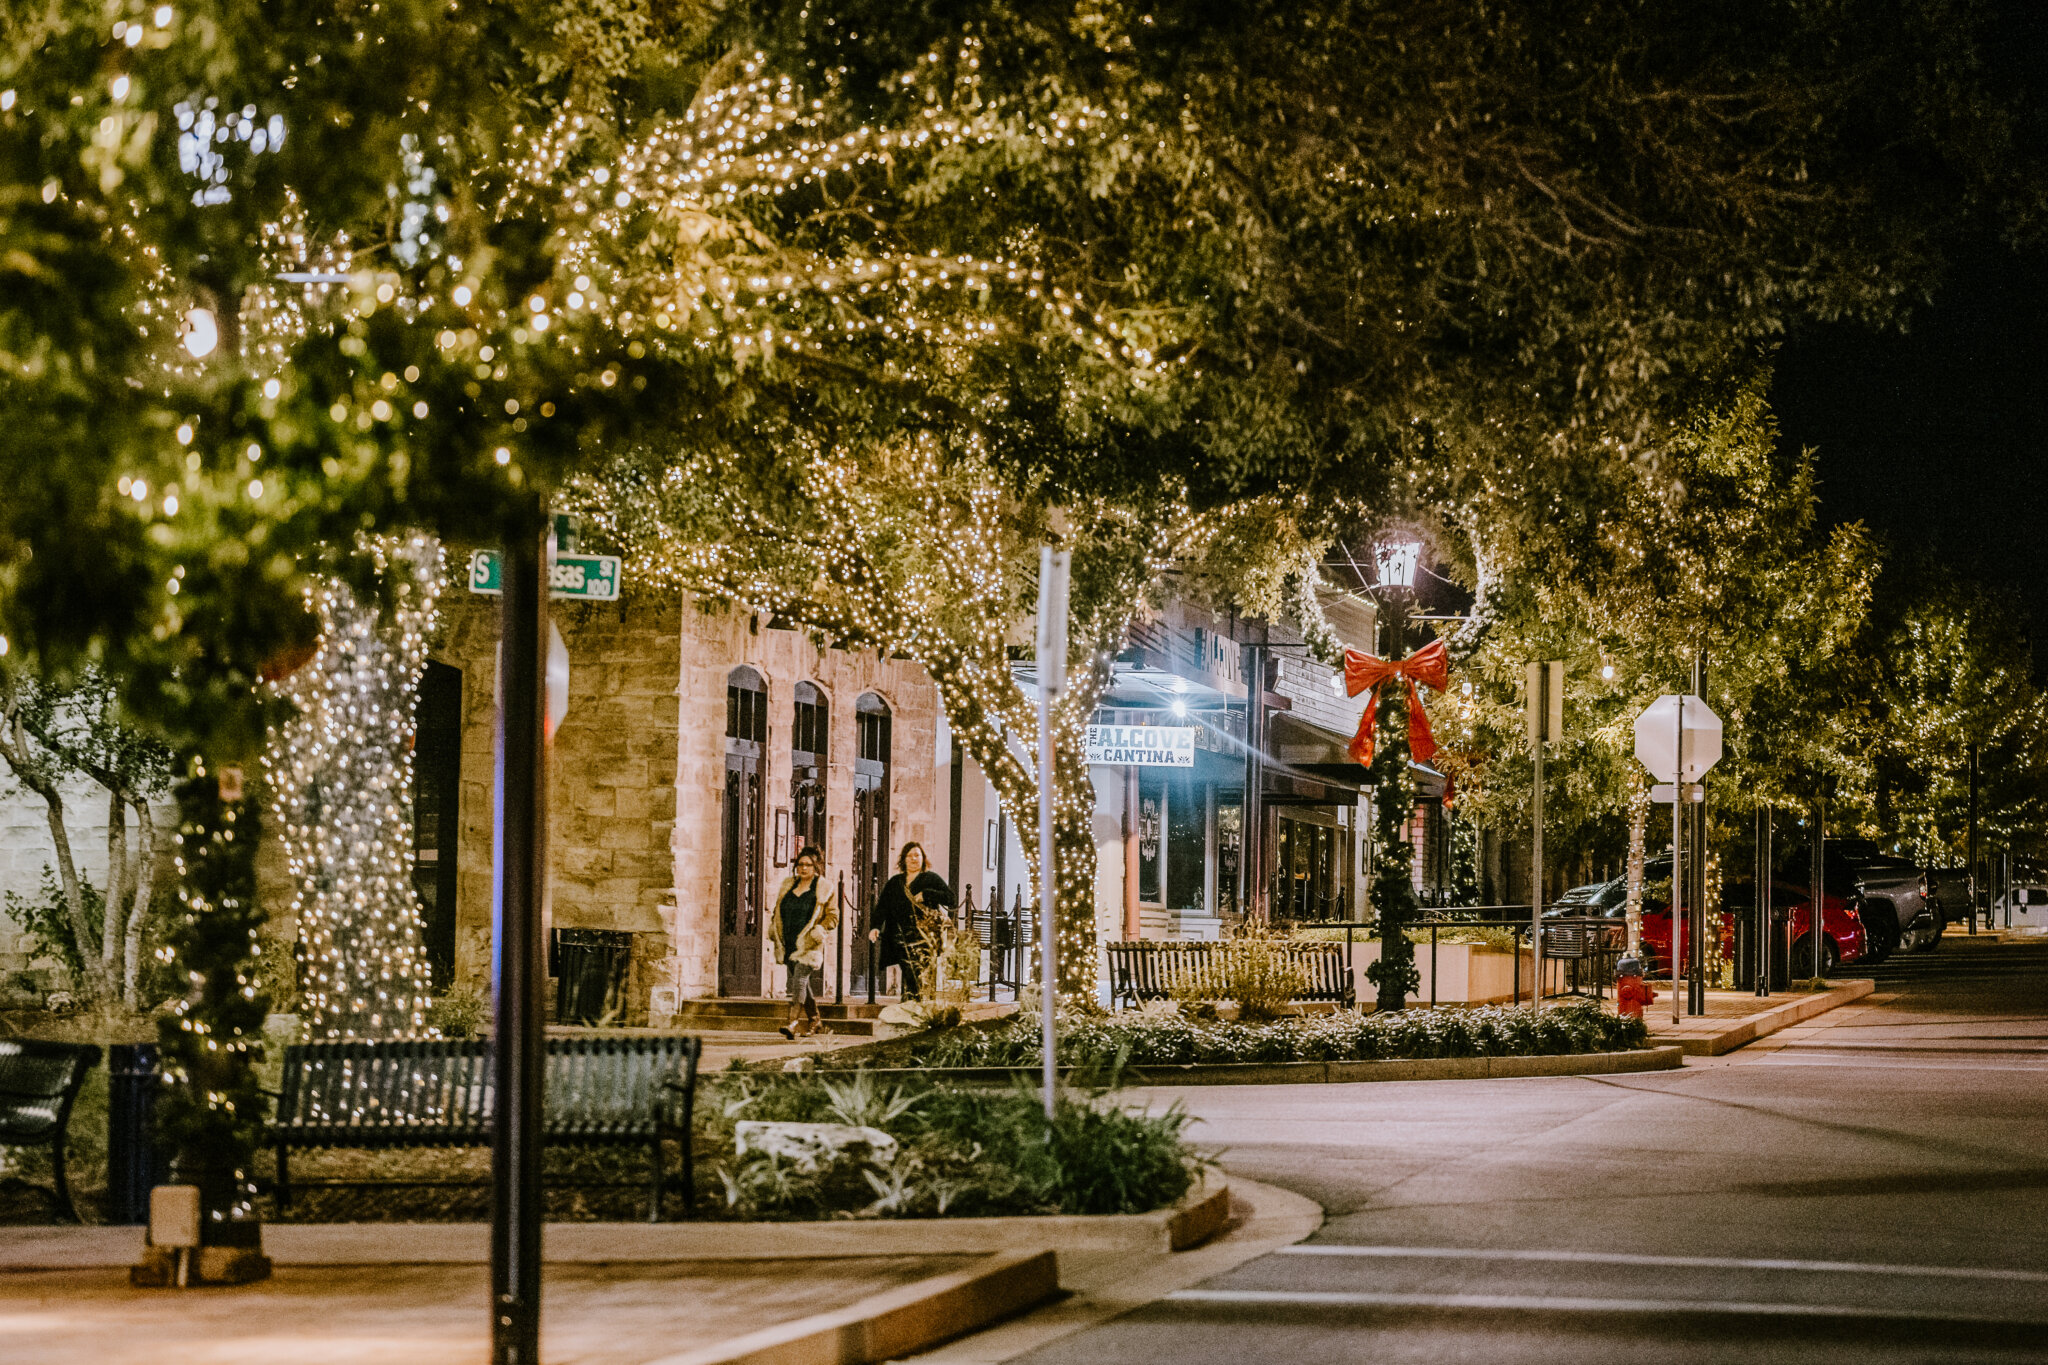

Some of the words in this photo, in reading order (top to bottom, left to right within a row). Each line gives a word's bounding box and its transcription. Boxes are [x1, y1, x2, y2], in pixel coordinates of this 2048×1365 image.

[475, 553, 490, 584] S
[587, 579, 611, 595] 100
[1089, 727, 1097, 746] THE
[1097, 728, 1190, 749] ALCOVE
[1104, 749, 1174, 763] CANTINA
